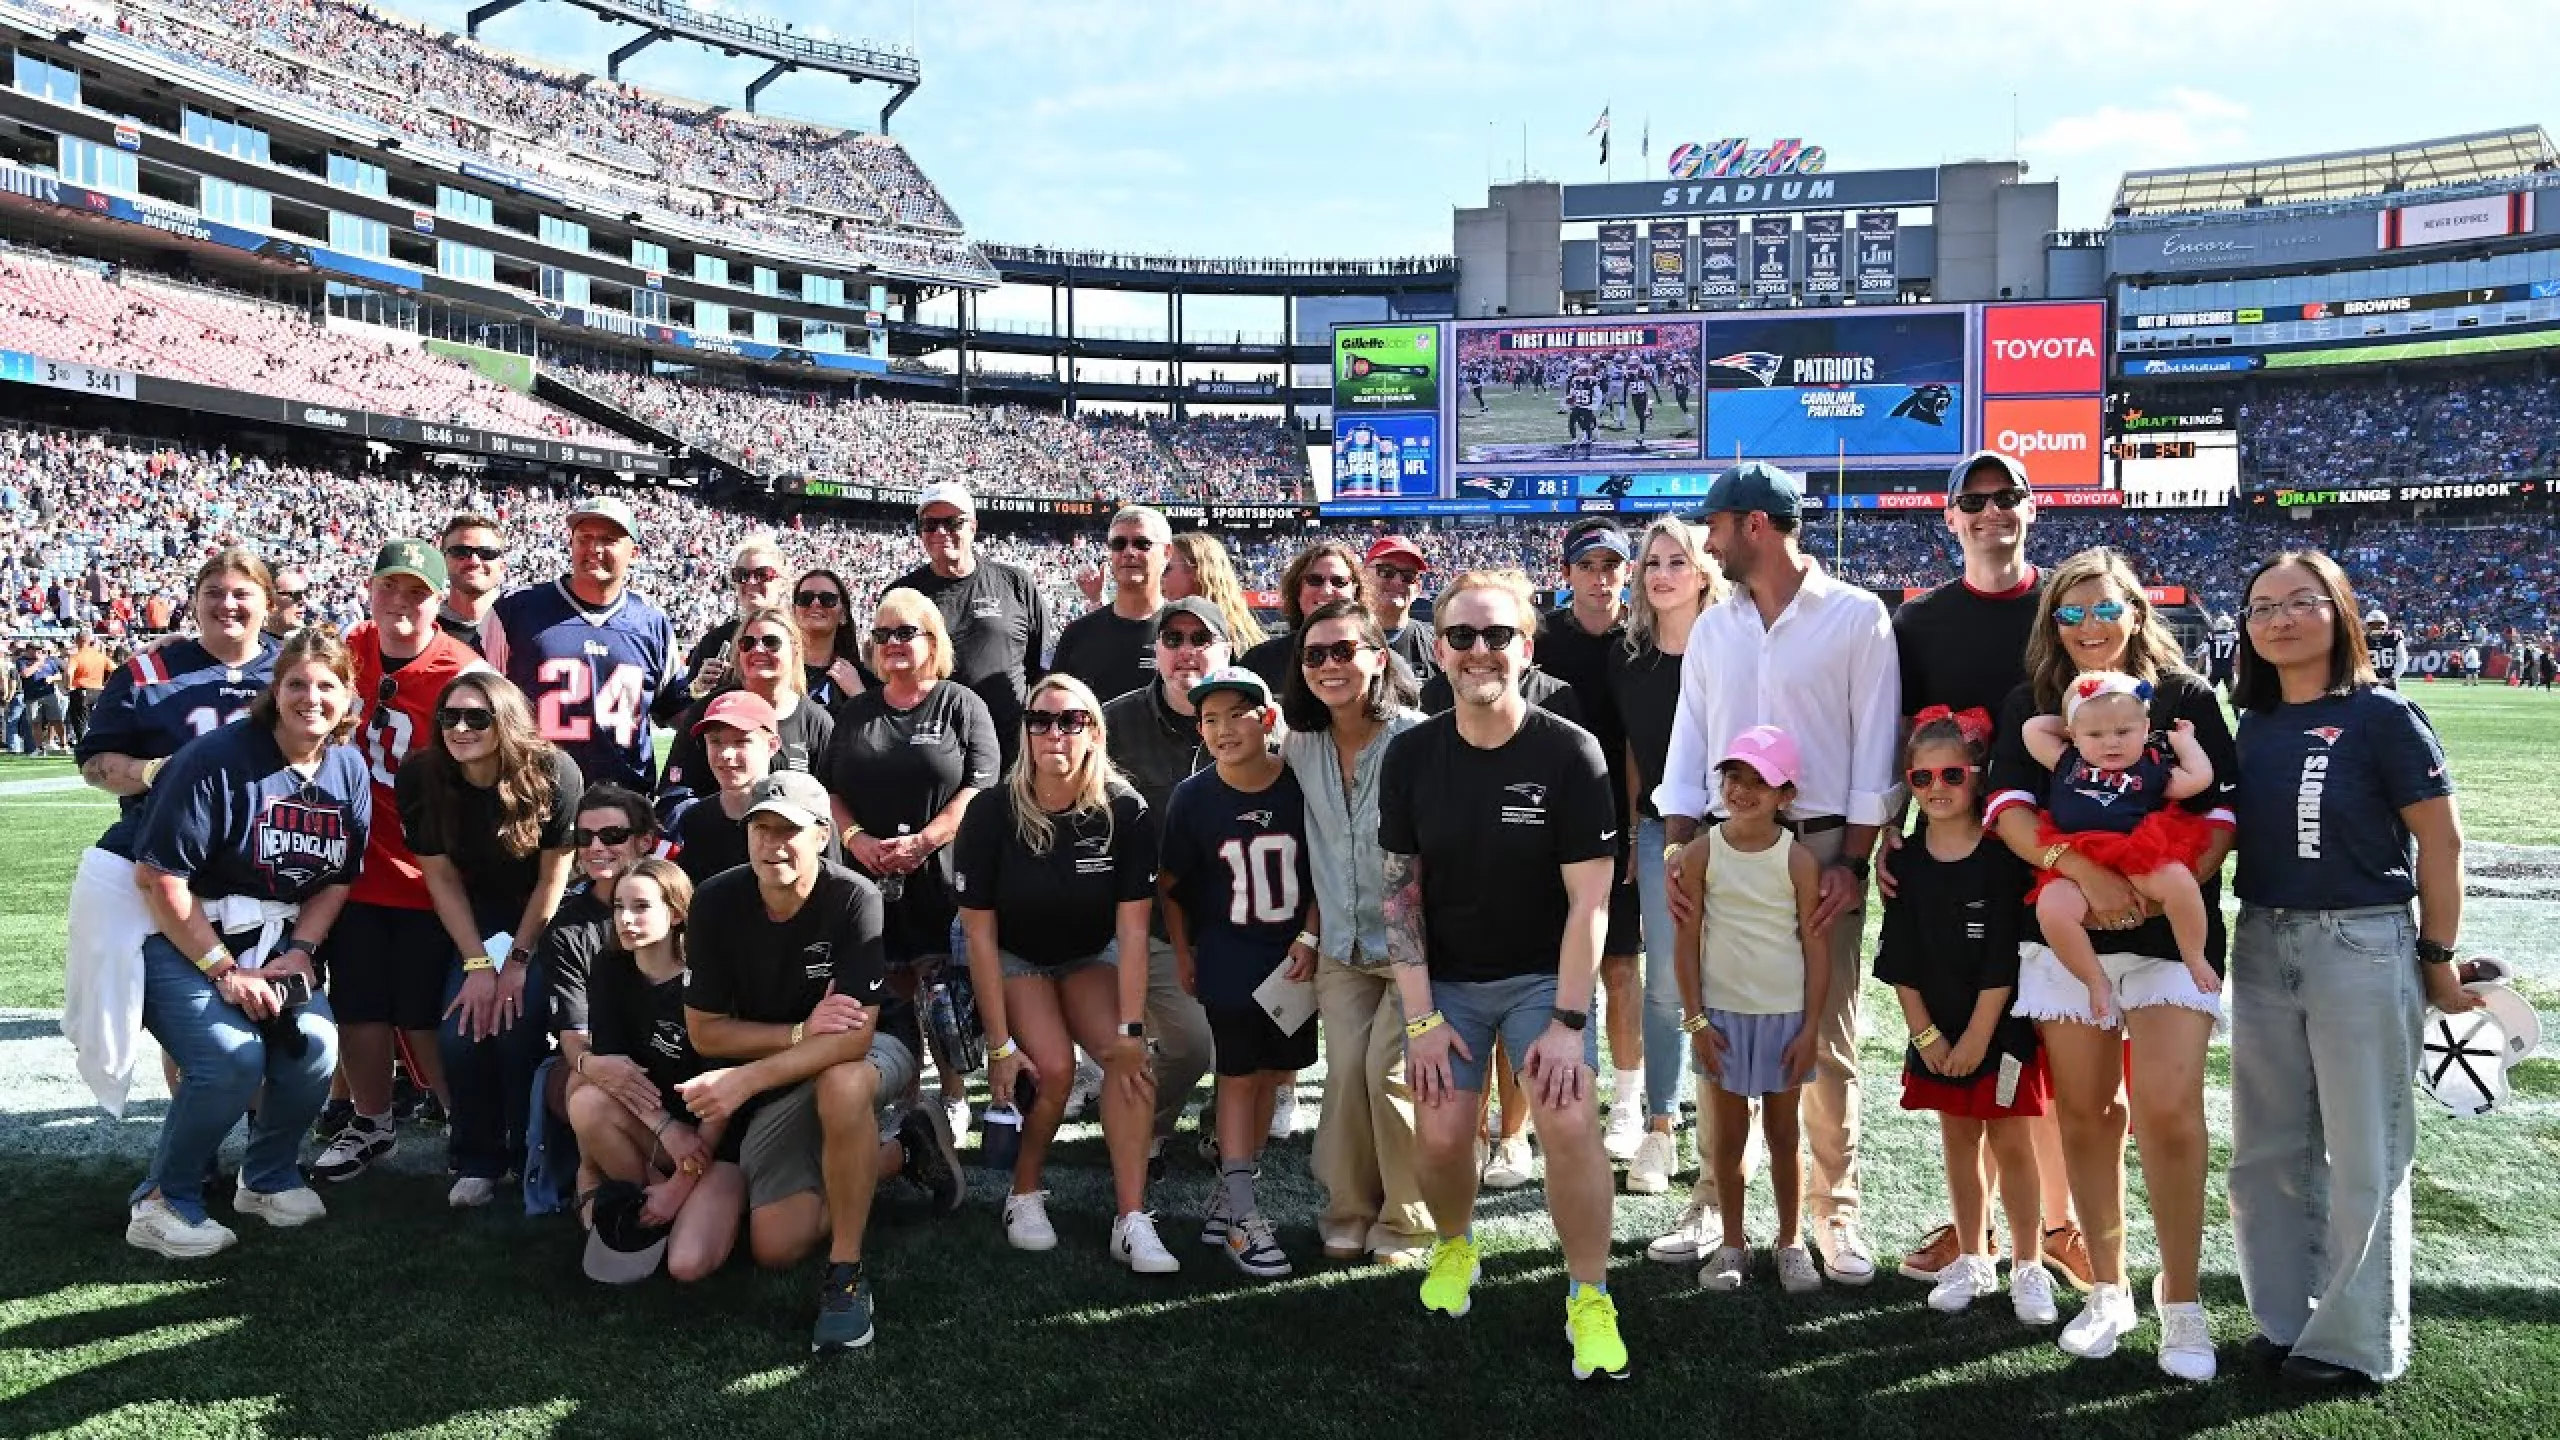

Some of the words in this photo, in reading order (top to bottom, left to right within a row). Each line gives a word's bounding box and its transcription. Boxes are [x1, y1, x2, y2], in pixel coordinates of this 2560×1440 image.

[1668, 138, 1826, 180] Gillette
[1661, 180, 1835, 206] STADIUM
[2453, 213, 2489, 226] EXPIRES
[2162, 233, 2254, 256] Encore
[2343, 298, 2411, 315] BROWNS
[1511, 333, 1543, 349] FIRST
[1547, 331, 1574, 347] HALF
[1577, 329, 1645, 347] HIGHLIGHTS
[1992, 337, 2096, 360] TOYOTA
[1794, 357, 1874, 382] PATRIOTS
[86, 369, 121, 393] 3:41
[1801, 391, 1856, 405] CAROLINA
[1807, 403, 1864, 417] PANTHERS
[2125, 414, 2223, 429] DRAFTKINGS
[1997, 429, 2087, 457] Optum
[1404, 459, 1429, 475] NFL
[805, 482, 873, 500] DRAFTKINGS
[1537, 479, 1556, 495] 28
[2276, 488, 2391, 507] DRAFTKINGS
[2399, 483, 2510, 501] SPORTSBOOK
[991, 500, 1035, 513] CROWN
[1039, 501, 1051, 513] IS
[1055, 501, 1093, 514] YOURS
[1880, 496, 1933, 507] TOYOTA
[2064, 493, 2119, 505] TOYOTA
[1211, 507, 1295, 519] SPORTSBOOK
[2213, 638, 2232, 660] 17
[537, 657, 645, 748] 24
[2297, 755, 2329, 859] PATRIOTS
[263, 827, 291, 859] NEW
[292, 832, 347, 868] ENGLAND
[1217, 832, 1301, 926] 10
